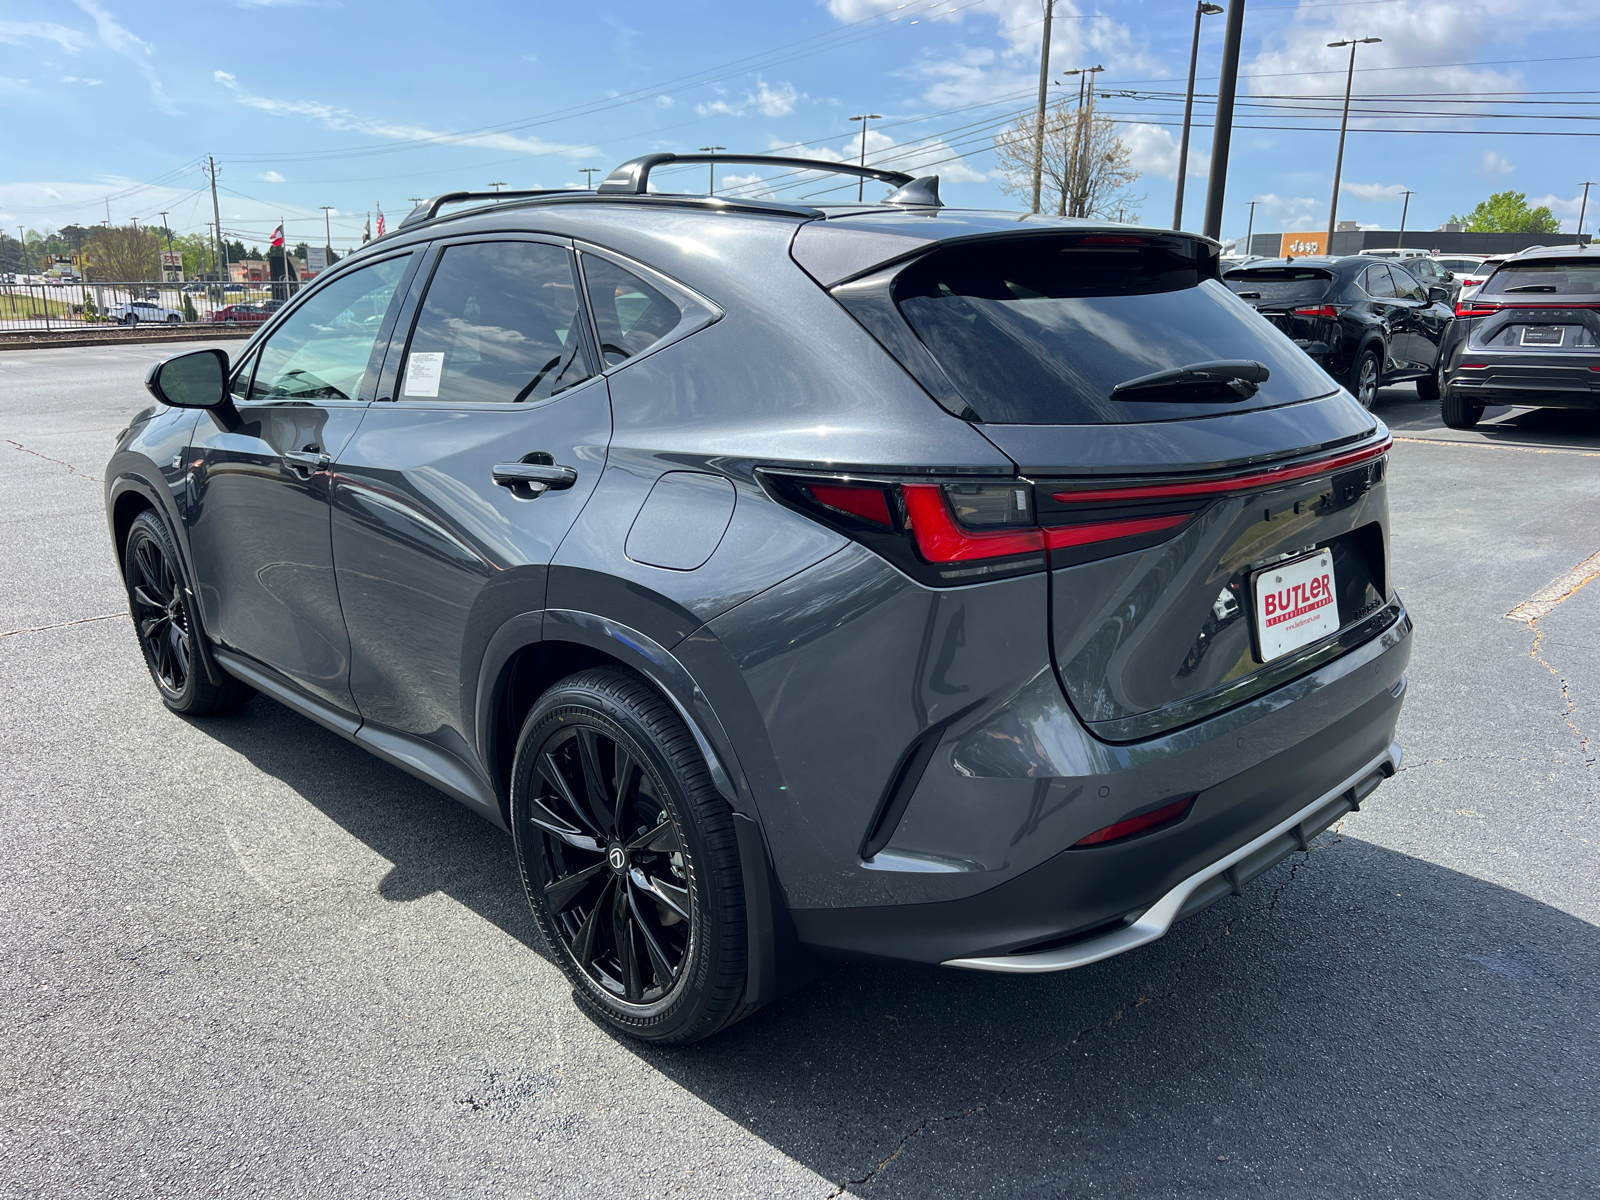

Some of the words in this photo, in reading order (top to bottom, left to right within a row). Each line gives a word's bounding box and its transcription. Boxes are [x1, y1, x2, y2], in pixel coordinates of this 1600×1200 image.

[1290, 240, 1319, 254] Jeep
[1266, 605, 1309, 627] AUTOMOTIVE
[1285, 614, 1321, 632] www.butlercars.com
[695, 913, 712, 993] BRIDGESTONE
